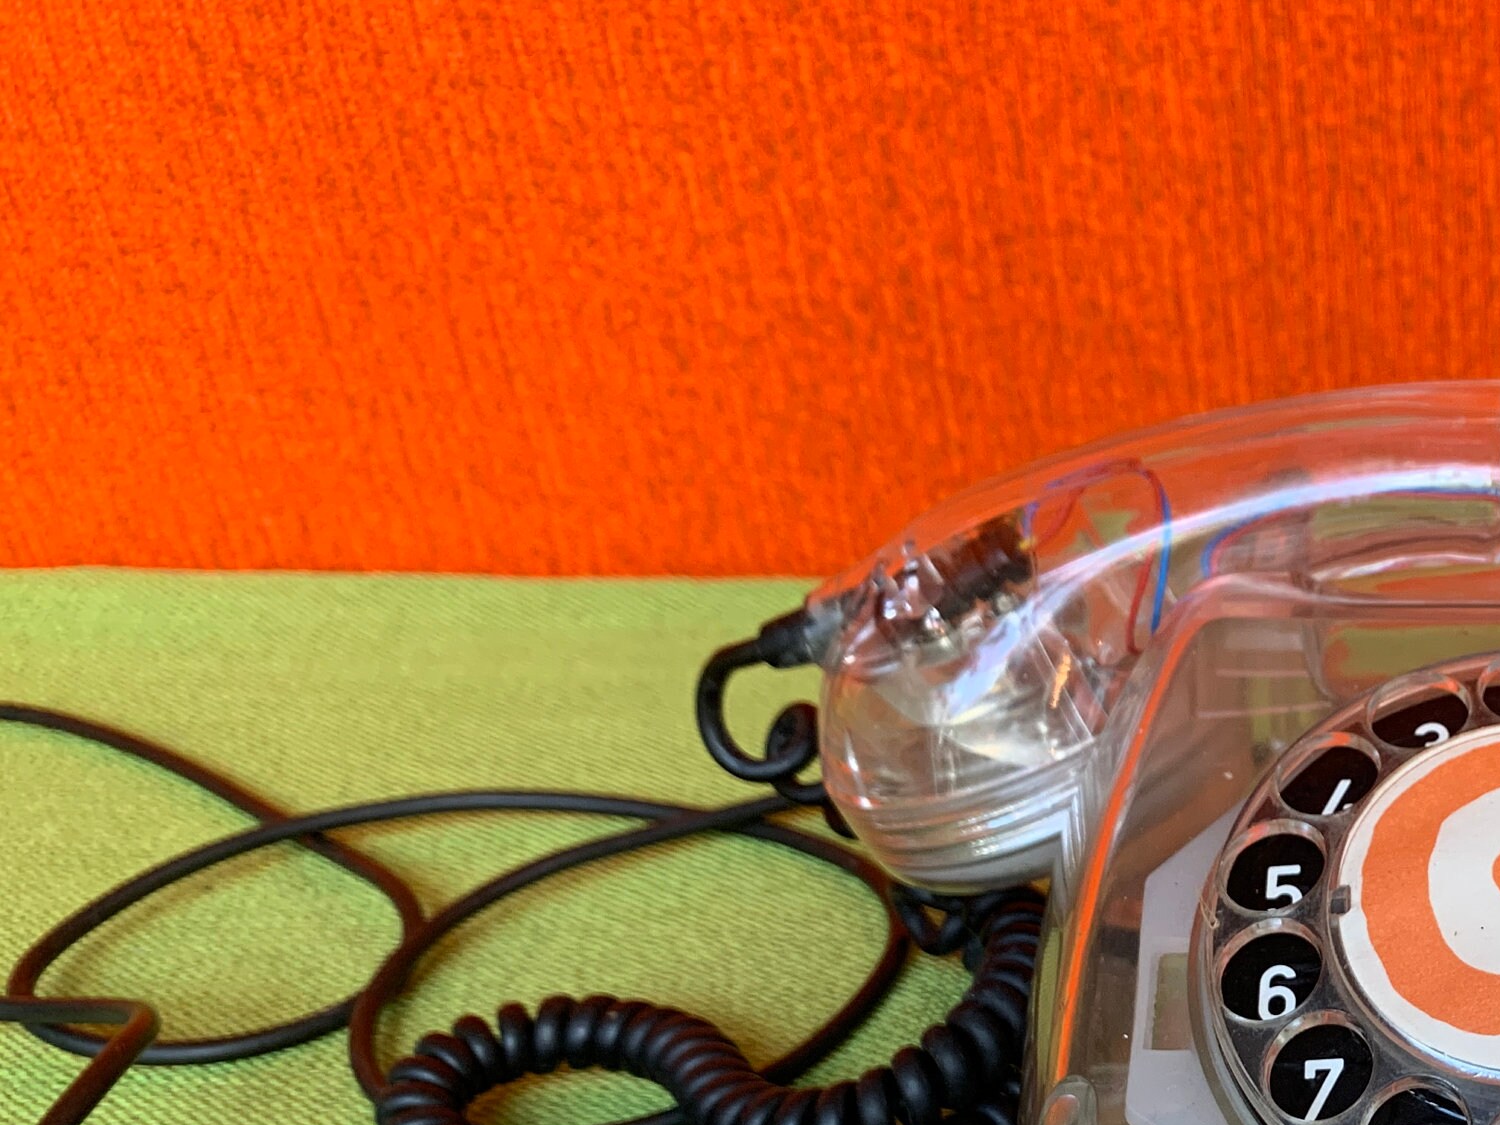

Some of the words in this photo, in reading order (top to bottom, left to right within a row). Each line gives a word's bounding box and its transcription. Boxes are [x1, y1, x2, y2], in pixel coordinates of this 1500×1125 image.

[1265, 864, 1303, 911] 5
[1257, 964, 1297, 1021] 6
[1303, 1057, 1345, 1122] 7
